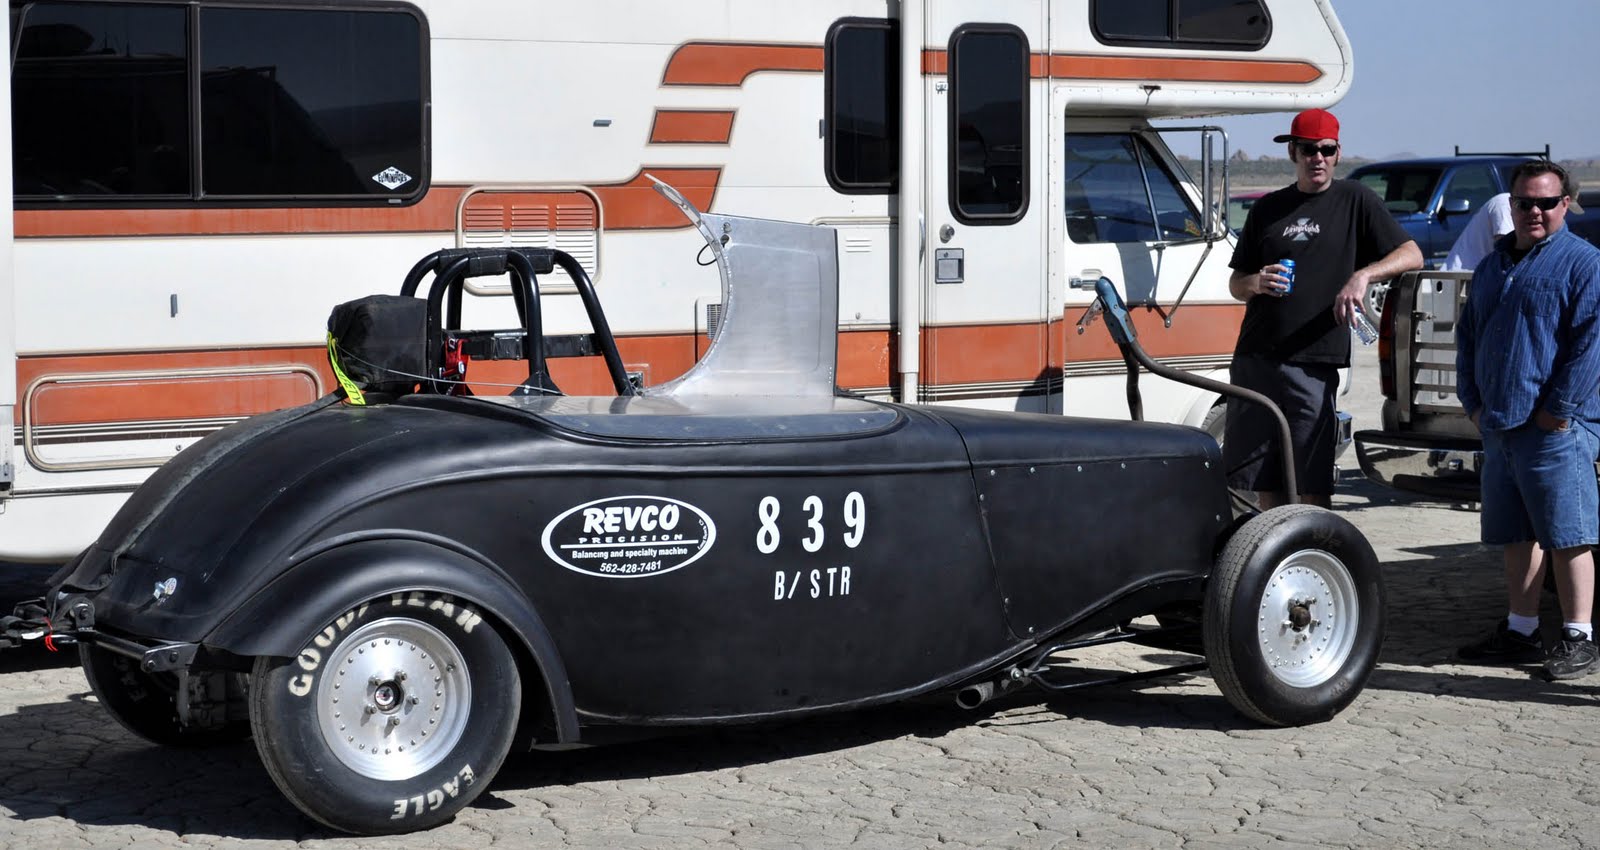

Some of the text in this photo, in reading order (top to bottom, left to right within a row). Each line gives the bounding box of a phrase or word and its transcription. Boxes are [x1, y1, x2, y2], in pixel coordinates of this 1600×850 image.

[582, 504, 680, 535] REVCO
[578, 534, 683, 544] PRECISION
[572, 546, 688, 560] Balancing and specialty machine
[599, 560, 662, 574] 562-428-7481
[390, 763, 476, 819] EAGLE
